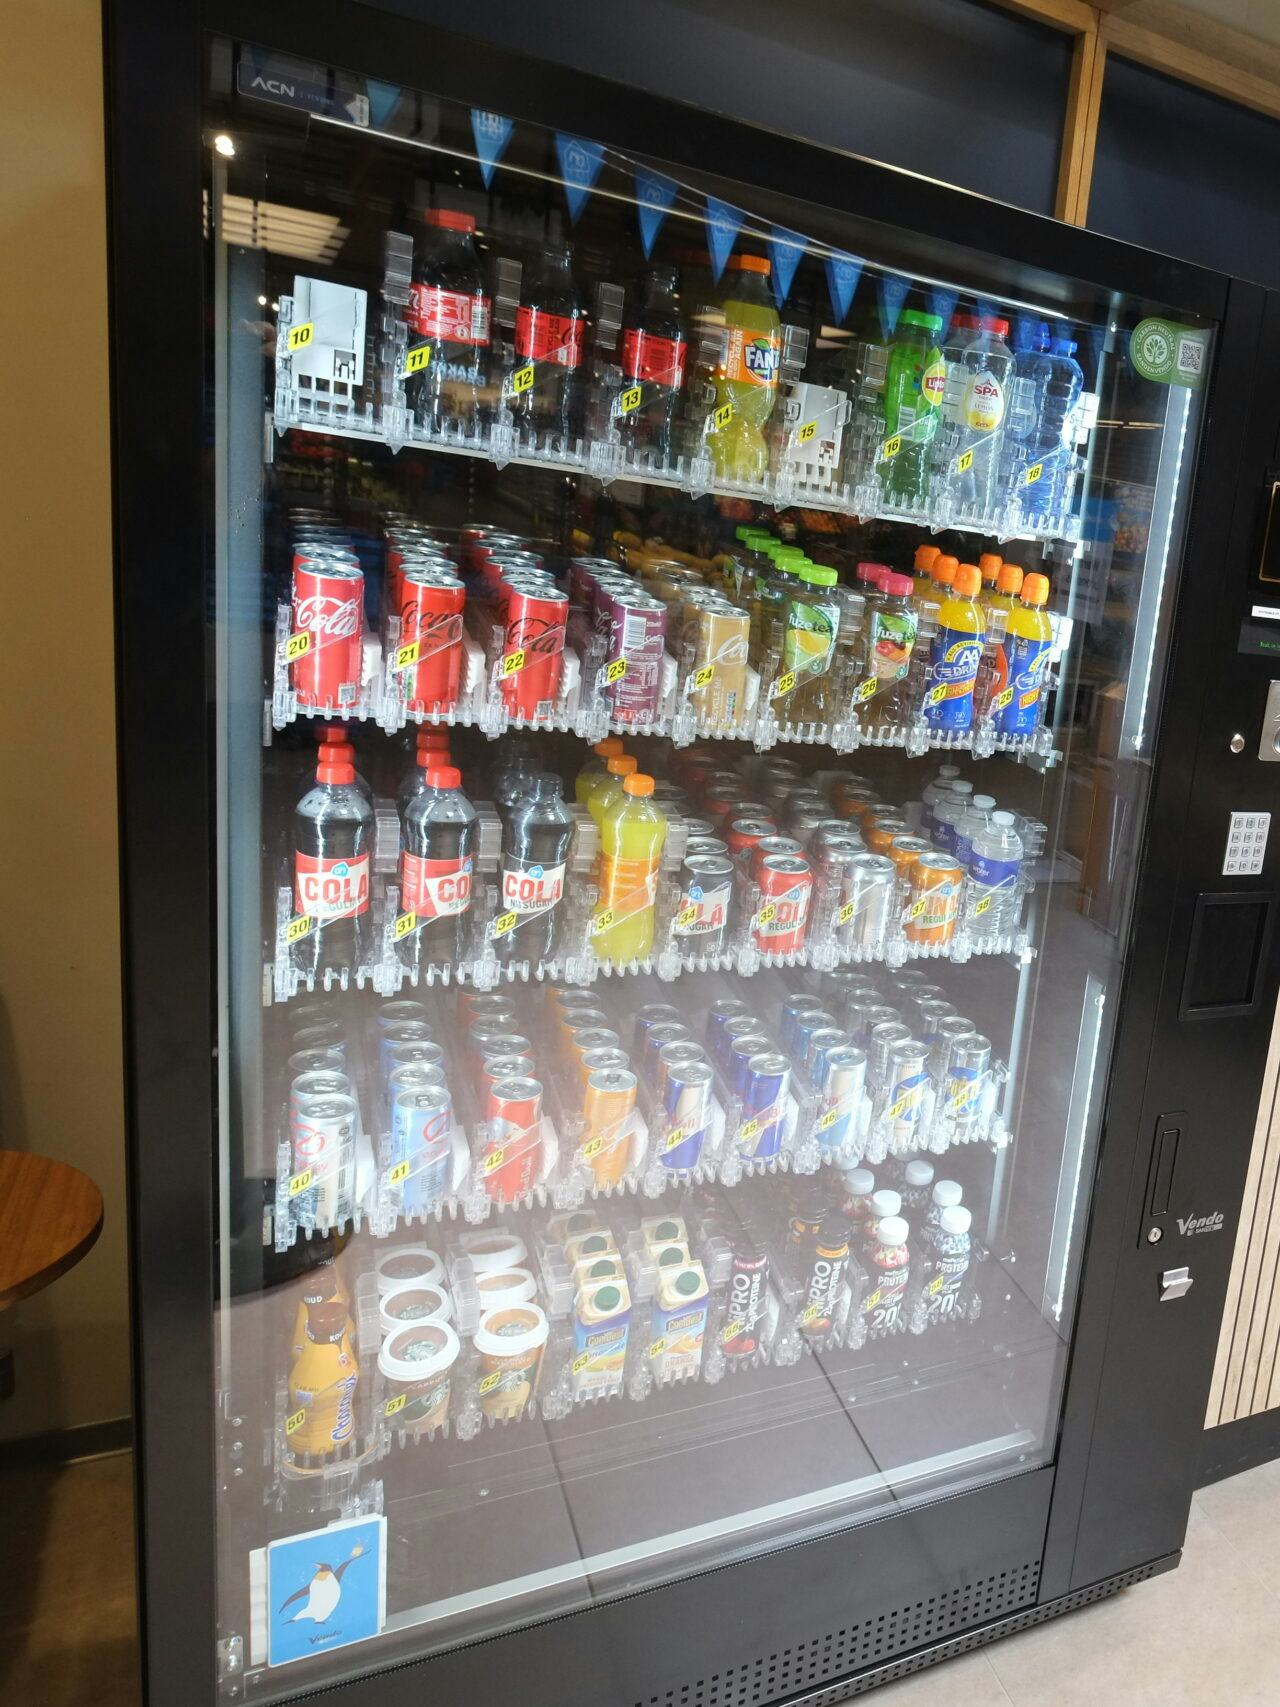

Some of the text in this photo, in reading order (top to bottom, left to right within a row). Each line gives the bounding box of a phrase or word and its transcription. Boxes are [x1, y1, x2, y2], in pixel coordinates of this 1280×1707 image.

[251, 76, 295, 97] ACN
[292, 328, 310, 345] 10
[1137, 325, 1176, 350] CARBON NEUTRAL
[735, 330, 743, 360] AGAIN
[410, 353, 424, 367] 11
[745, 346, 780, 369] FANT
[516, 371, 531, 387] 12
[974, 384, 999, 398] SPA
[624, 392, 639, 407] 13
[717, 408, 730, 423] 14
[801, 424, 814, 439] 15
[886, 438, 899, 453] 16
[960, 454, 971, 469] 17
[1028, 468, 1039, 481] 18
[296, 596, 359, 636] Cola
[289, 637, 308, 654] 20
[399, 648, 416, 664] 21
[505, 655, 523, 671] 22
[609, 662, 626, 678] 23
[697, 671, 713, 685] 24
[780, 676, 794, 691] 25
[862, 680, 876, 695] 26
[933, 686, 947, 700] 27
[1000, 690, 1013, 704] 28
[304, 873, 368, 904] COLA
[437, 876, 469, 903] CO
[505, 874, 561, 901] COLA
[840, 905, 853, 919] 36
[912, 901, 925, 915] 37
[977, 898, 990, 911] 38
[599, 914, 613, 928] 33
[681, 910, 695, 922] 34
[760, 908, 774, 921] 35
[398, 918, 412, 932] 31
[498, 915, 515, 930] 32
[289, 923, 307, 938] 30
[890, 1103, 902, 1116] 47
[822, 1112, 835, 1126] 46
[669, 1130, 682, 1144] 44
[585, 1139, 600, 1153] 43
[487, 1152, 503, 1166] 42
[391, 1165, 408, 1180] 41
[292, 1175, 310, 1190] 40
[1176, 1211, 1224, 1236] Vendo
[482, 1375, 498, 1389] 52
[387, 1398, 402, 1412] 51
[288, 1413, 304, 1430] 50
